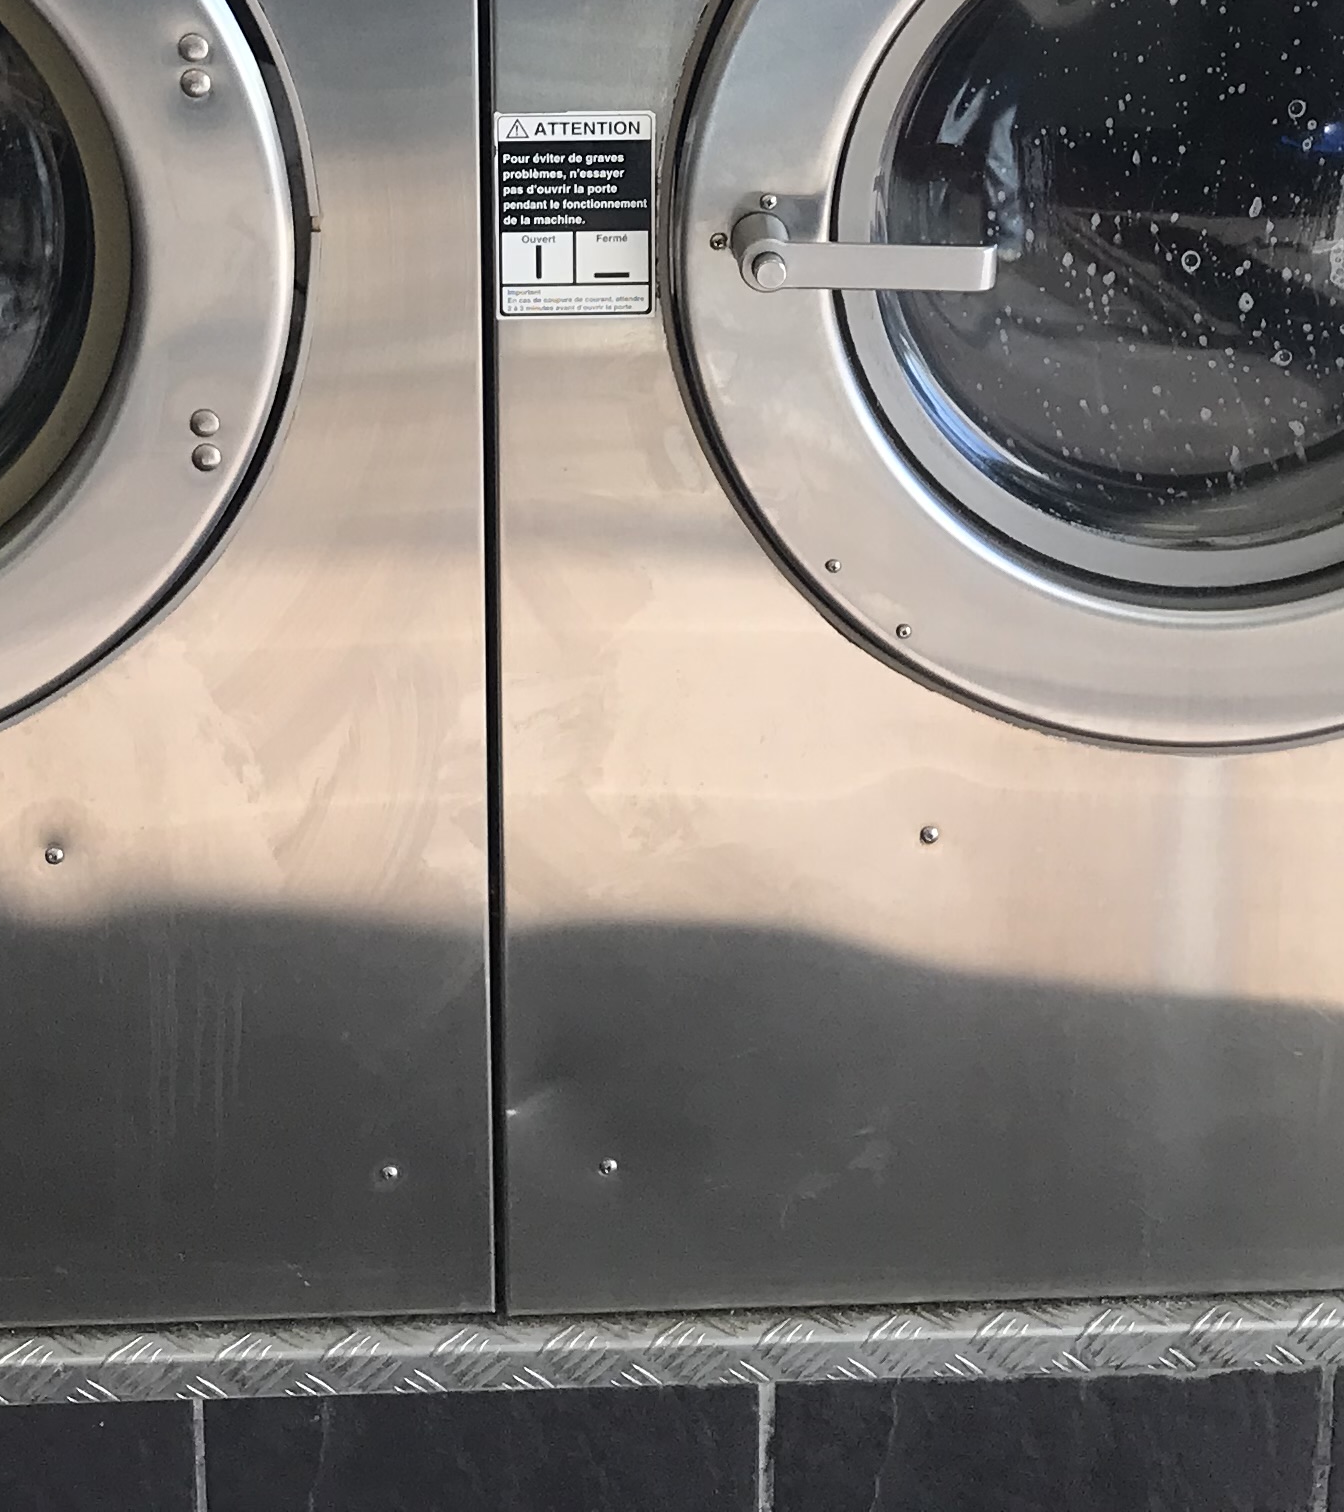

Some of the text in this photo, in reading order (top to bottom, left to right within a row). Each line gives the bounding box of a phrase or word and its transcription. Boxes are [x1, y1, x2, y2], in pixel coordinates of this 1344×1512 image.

[534, 122, 640, 135] ATTENTION
[503, 153, 624, 165] Pour éviter de graves
[503, 169, 625, 181] problèmes, n'essayer
[503, 184, 617, 196] pas d'ouvrir la porte
[503, 199, 648, 212] pendant le fonctionnement
[503, 215, 586, 225] de la machine.
[522, 235, 556, 243] Ouvert
[596, 234, 628, 242] Fermé
